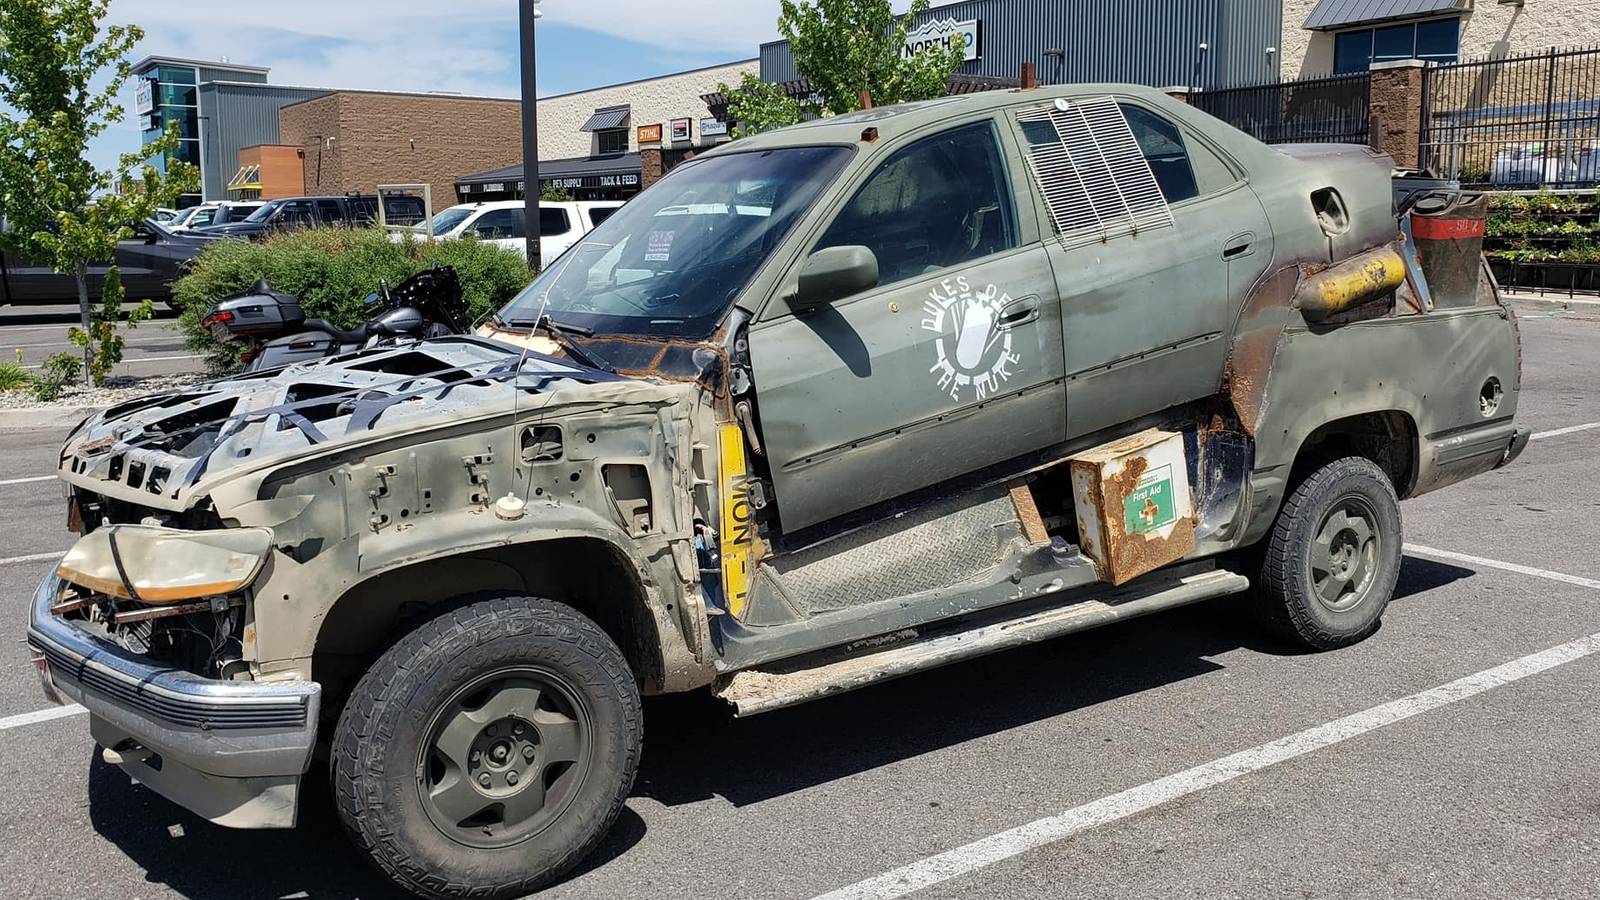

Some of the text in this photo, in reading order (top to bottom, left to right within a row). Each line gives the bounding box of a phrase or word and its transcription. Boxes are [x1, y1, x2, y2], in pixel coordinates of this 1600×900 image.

[640, 129, 658, 140] STIHL
[563, 178, 582, 188] SUPPLY
[600, 175, 638, 186] TACK & FEED
[921, 276, 970, 333] DUKES
[929, 353, 1021, 402] THE NUKE
[1133, 484, 1162, 502] First Aid
[732, 474, 752, 545] MON
